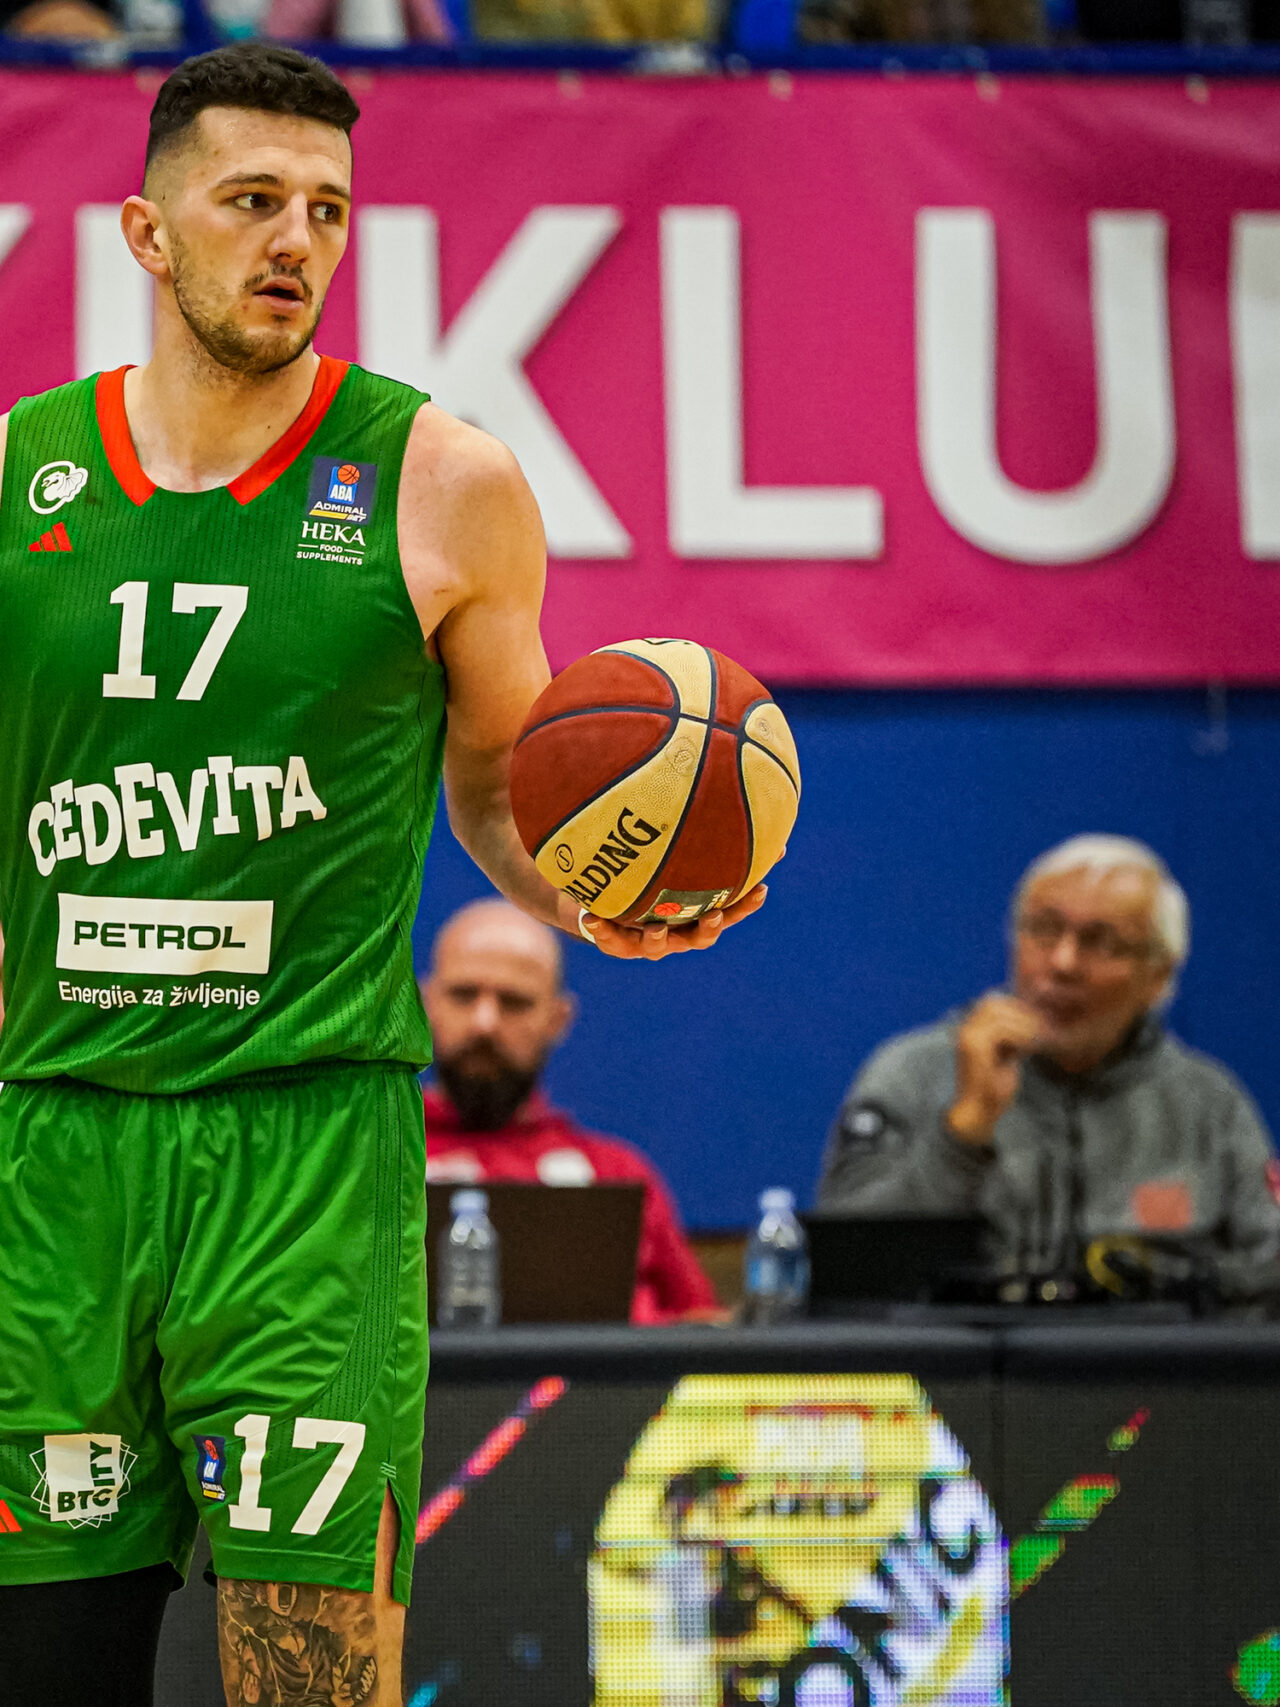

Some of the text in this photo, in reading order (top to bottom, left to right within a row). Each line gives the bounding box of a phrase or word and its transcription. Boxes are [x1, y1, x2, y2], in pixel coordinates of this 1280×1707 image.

[329, 484, 353, 502] ABA
[313, 501, 367, 517] ADMIRAL
[301, 521, 366, 546] HEKA
[296, 551, 363, 565] SUPPLEMENTS
[319, 544, 343, 553] FOOD
[102, 580, 249, 701] 17
[28, 755, 327, 876] CEDEVITA
[561, 807, 662, 907] ALDING
[73, 921, 246, 951] PETROL
[58, 980, 260, 1010] Energija za življenje
[228, 1413, 366, 1536] 17
[57, 1488, 112, 1513] BTC
